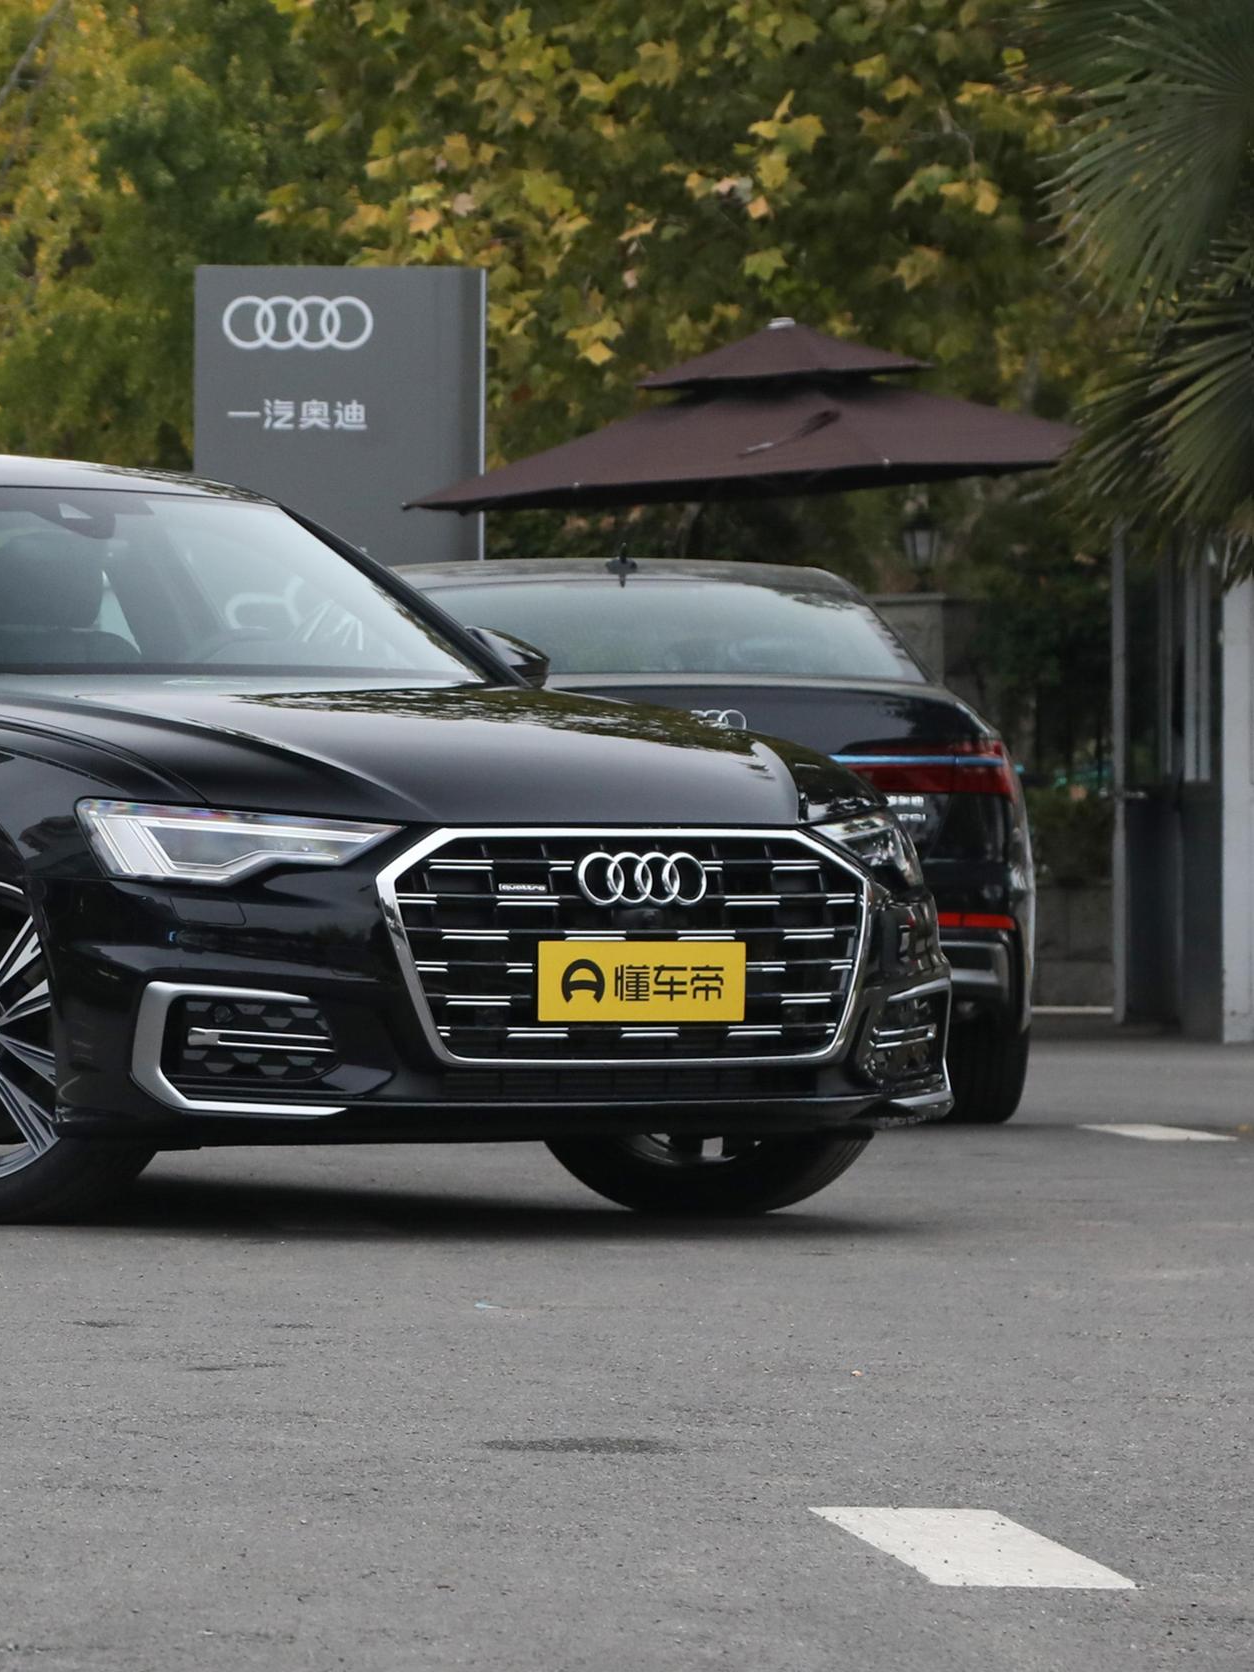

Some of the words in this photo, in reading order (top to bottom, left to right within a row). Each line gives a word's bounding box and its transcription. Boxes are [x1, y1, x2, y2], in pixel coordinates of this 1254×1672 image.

[227, 399, 368, 431] 一汽奥迪
[614, 964, 725, 1001] 懂车帝
